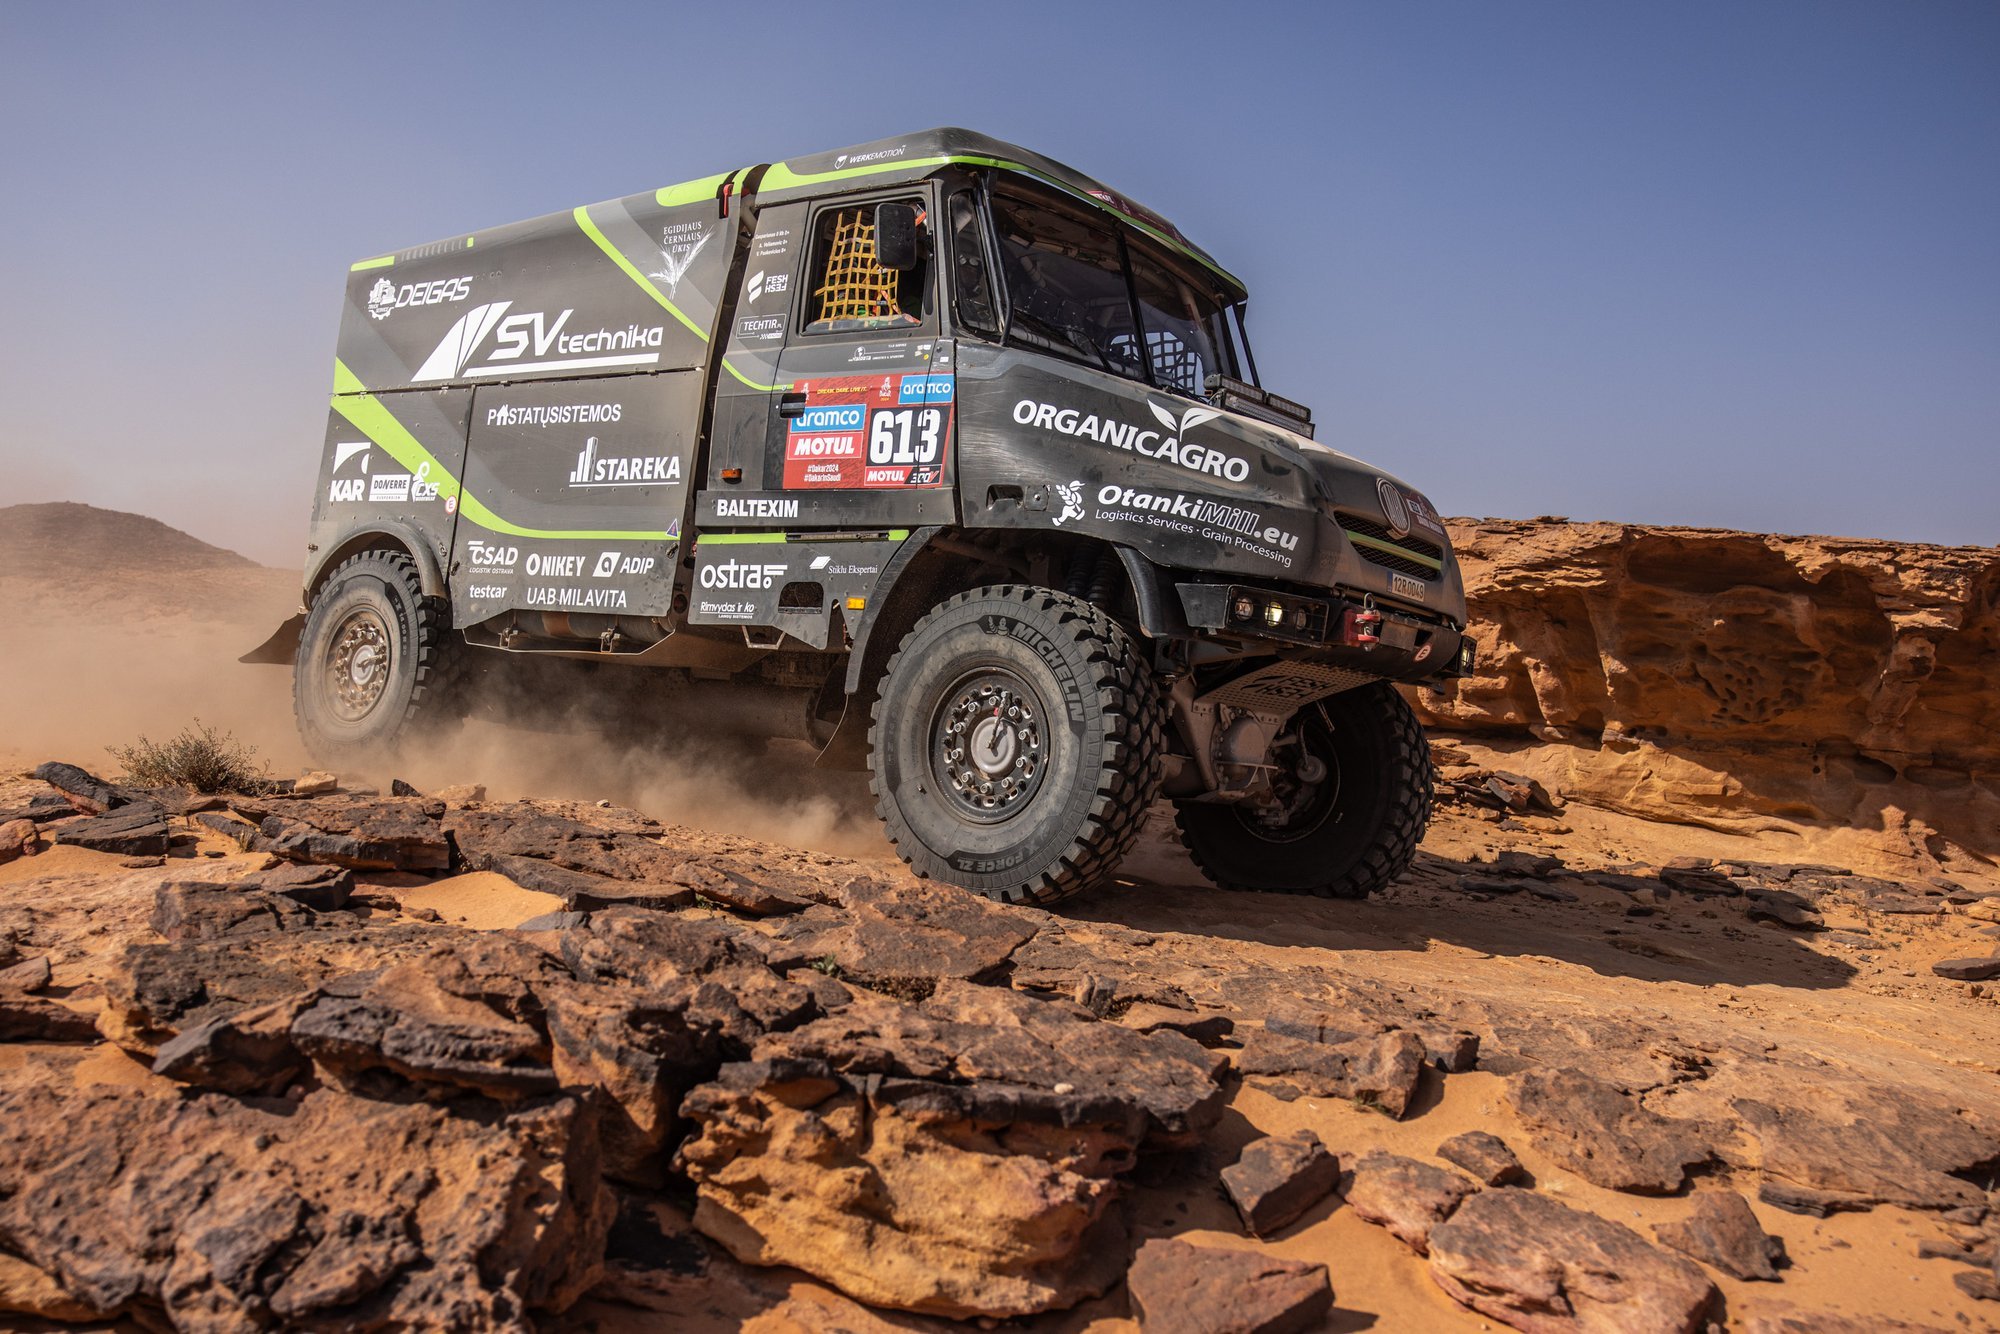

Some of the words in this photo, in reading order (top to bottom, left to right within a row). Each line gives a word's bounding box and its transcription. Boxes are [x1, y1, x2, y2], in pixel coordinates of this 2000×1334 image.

[849, 147, 905, 164] WERKEMOTION
[663, 221, 702, 235] EGIDIJAUS
[663, 231, 701, 245] ČERNIAUS
[766, 274, 789, 285] FESH
[394, 276, 473, 308] DEIGAS
[558, 325, 663, 354] technika
[902, 382, 951, 396] aramco
[796, 410, 859, 428] aramco
[869, 409, 941, 464] 613
[1013, 400, 1250, 482] ORGANICAGRO
[794, 437, 855, 456] MOTUL
[594, 456, 680, 481] STAREKA
[867, 470, 905, 482] MOTUL
[329, 479, 365, 502] KAR
[717, 499, 798, 518] BALTEXIM
[1098, 485, 1299, 551] OtankiMill.eu
[1095, 508, 1144, 523] Logistics
[1147, 514, 1194, 533] Services
[1202, 527, 1232, 545] Grain
[1234, 537, 1292, 568] Processing
[620, 557, 655, 575] ADIP
[469, 584, 507, 599] testcar
[527, 587, 556, 604] UAB
[558, 588, 627, 607] MILAVITA
[700, 601, 736, 613] Rimvydas
[737, 602, 743, 612] ir
[743, 602, 755, 613] ko
[1011, 621, 1085, 722] MICHELIN
[957, 858, 975, 871] ZL
[976, 850, 1024, 872] FORCE
